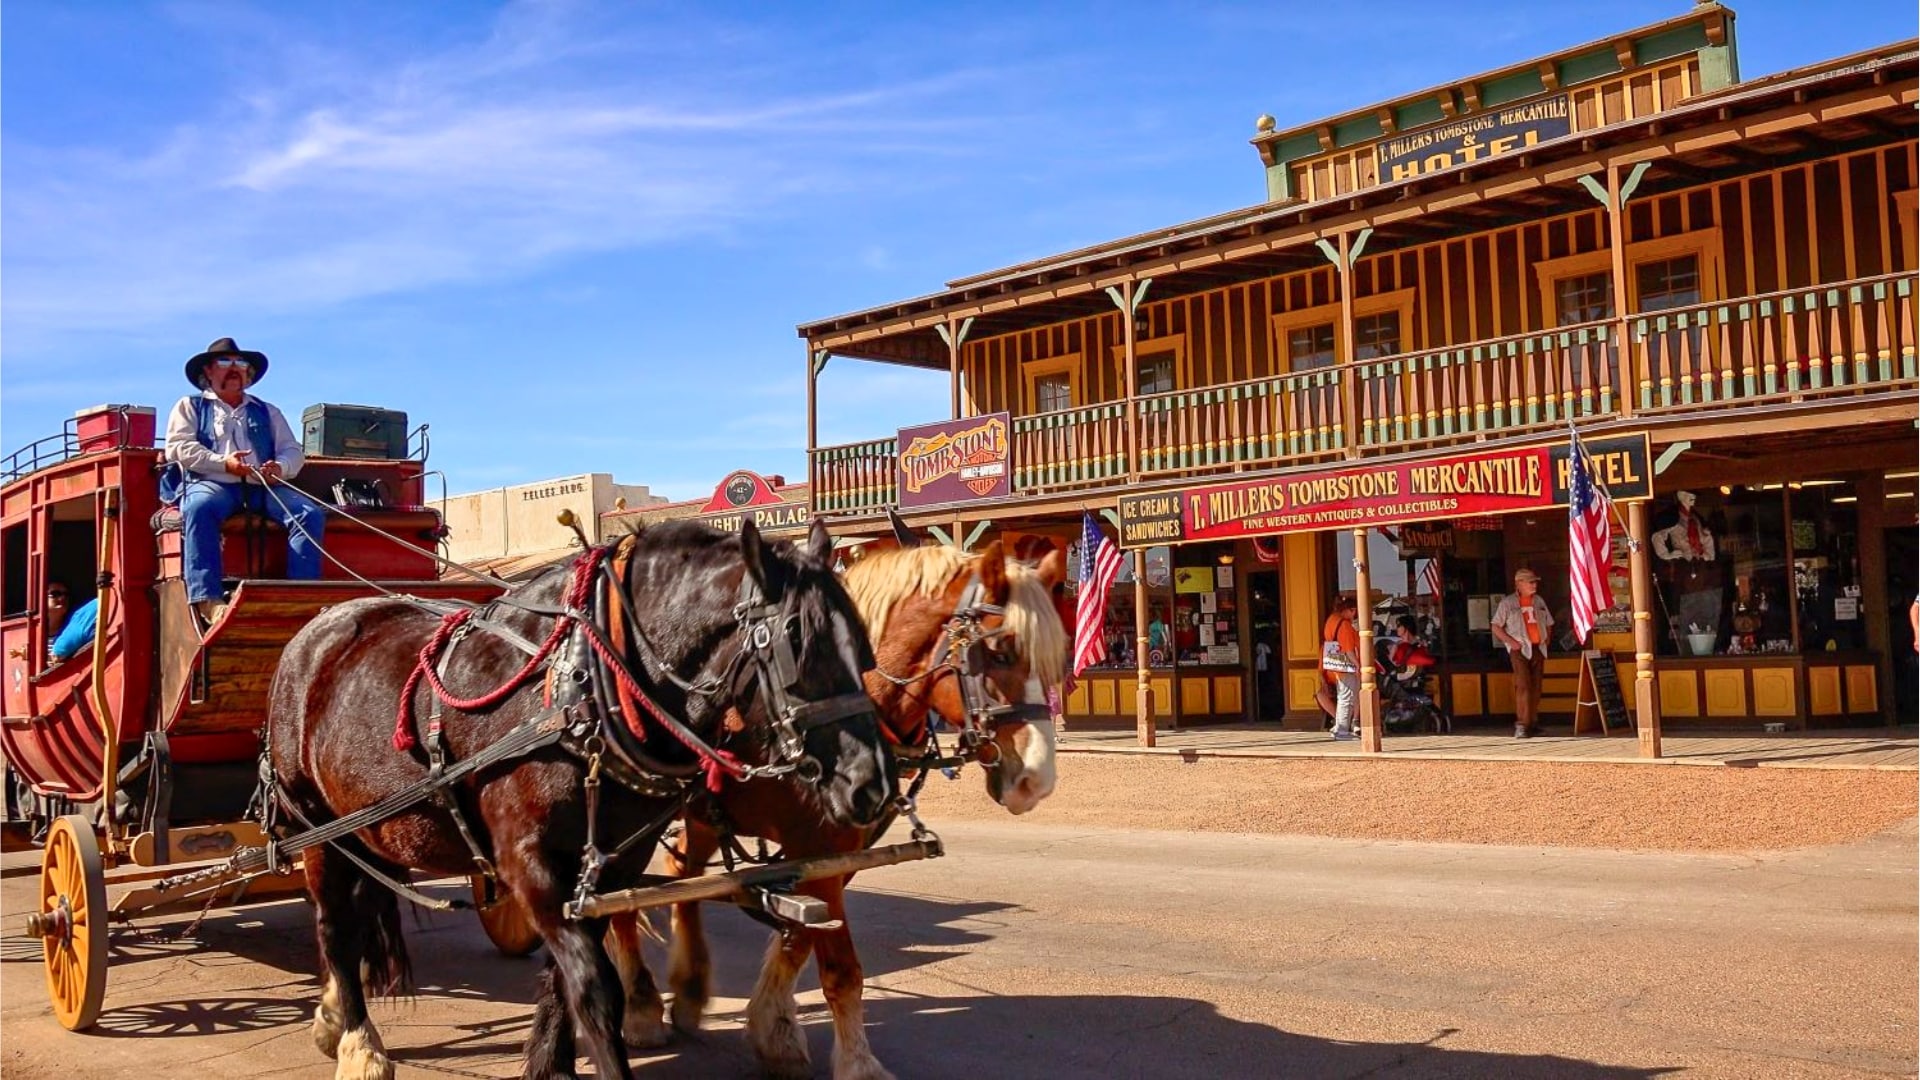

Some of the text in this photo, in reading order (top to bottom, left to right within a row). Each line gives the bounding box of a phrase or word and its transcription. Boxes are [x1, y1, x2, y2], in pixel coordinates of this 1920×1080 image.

[1379, 144, 1388, 163] T.
[1434, 115, 1495, 142] TOMBSTONE
[1500, 97, 1567, 126] MERCANTILE
[1463, 134, 1477, 147] &
[905, 424, 1002, 489] TOMBSTONE
[1190, 455, 1542, 531] T. MILLER'S TOMBSTONE MERCANTILE
[755, 507, 807, 528] PALAC
[1122, 496, 1180, 519] ICE CREAM &
[1243, 498, 1458, 530] FINE WESTERN ANTIQUES & COLLECTIBLES
[1125, 519, 1180, 541] SANDWICHES
[1404, 527, 1453, 547] SANDWICH
